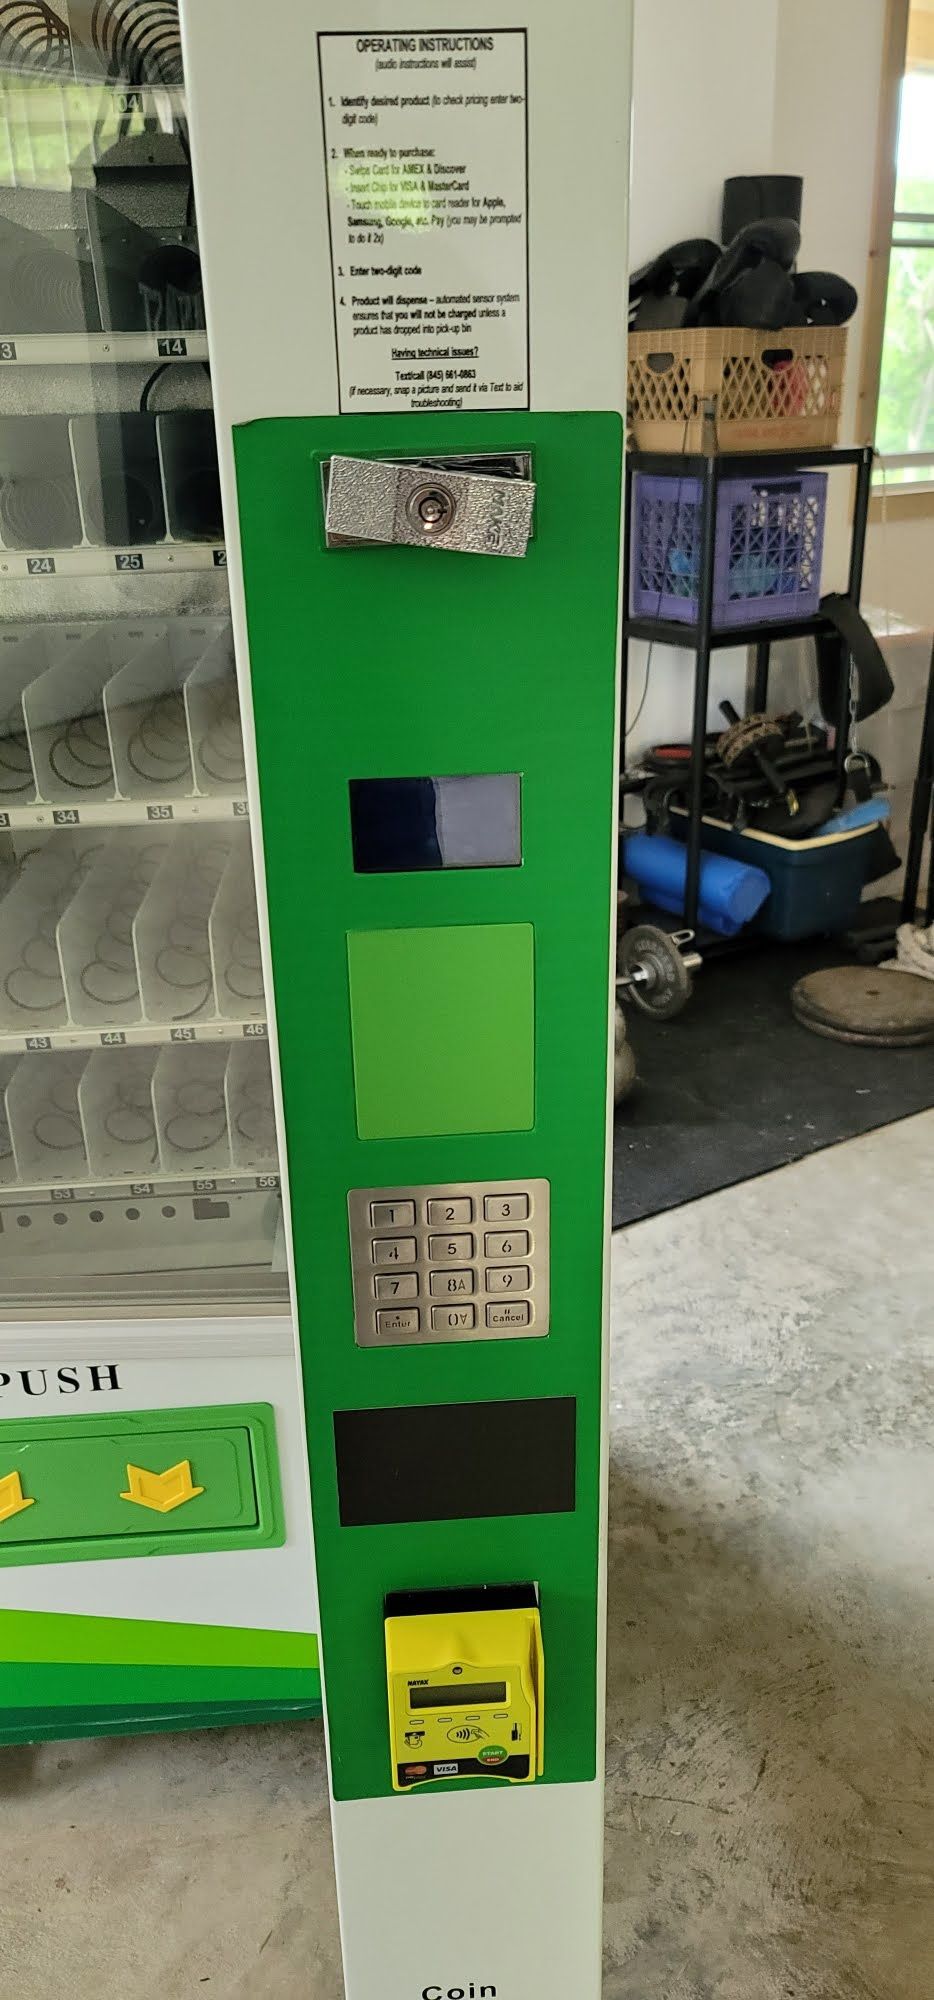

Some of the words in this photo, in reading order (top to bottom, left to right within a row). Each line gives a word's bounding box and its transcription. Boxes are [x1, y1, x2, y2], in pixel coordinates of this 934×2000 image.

[356, 39, 416, 52] OPERATING
[419, 37, 494, 51] INSTRUCTIONS
[375, 59, 397, 71] (audio
[399, 58, 439, 69] instructions
[442, 58, 452, 68] will
[454, 57, 476, 70] assist)
[329, 97, 335, 107] 1.
[341, 96, 369, 108] Identify
[371, 96, 398, 106] desired
[401, 95, 429, 107] product
[432, 95, 441, 107] (to
[443, 95, 463, 105] check
[465, 95, 488, 107] pricing
[490, 95, 507, 104] enter
[342, 114, 356, 126] digit
[359, 113, 378, 125] code)
[332, 149, 338, 159] 2.
[344, 148, 364, 158] When
[367, 149, 387, 159] ready
[389, 149, 397, 157] to
[399, 148, 435, 159] purchase:
[349, 164, 370, 177] Swipe
[373, 165, 389, 175] Card
[392, 165, 400, 175] for
[402, 164, 424, 174] AMEX
[434, 164, 466, 174] Discover
[351, 182, 370, 192] Insert
[401, 181, 418, 191] VISA
[428, 181, 469, 190] MasterCard
[351, 199, 372, 209] Touch
[431, 199, 446, 208] card
[448, 199, 470, 208] reader
[472, 198, 481, 207] for
[483, 198, 505, 209] Apple,
[347, 217, 383, 228] Samsung,
[386, 217, 414, 228] Google,
[431, 216, 444, 227] Pay
[447, 216, 460, 228] (you
[463, 217, 477, 226] may
[480, 215, 488, 224] be
[490, 214, 522, 225] prompted
[349, 235, 355, 243] to
[357, 235, 365, 243] do
[374, 233, 384, 244] 2x)
[338, 267, 344, 276] 3.
[350, 266, 369, 276] Enter
[371, 265, 403, 278] two-digit
[405, 265, 422, 275] code
[340, 297, 346, 306] 4.
[351, 296, 380, 306] Product
[382, 295, 394, 305] will
[396, 295, 428, 306] dispense
[436, 294, 470, 304] automated
[473, 295, 495, 303] sensor
[497, 293, 520, 305] system
[352, 311, 379, 321] ensures
[381, 311, 393, 320] that
[395, 312, 408, 322] you
[411, 310, 422, 319] will
[424, 310, 435, 319] not
[438, 310, 446, 318] be
[448, 309, 476, 320] charged
[479, 309, 500, 318] unless
[353, 326, 378, 337] product
[380, 325, 392, 334] has
[394, 324, 420, 336] dropped
[422, 324, 434, 333] into
[436, 323, 460, 335] pick-up
[462, 323, 472, 332] bin
[161, 340, 183, 354] 14
[392, 348, 416, 359] Having
[418, 347, 449, 357] technical
[452, 347, 479, 356] issues?
[395, 371, 425, 380] Text/call
[427, 370, 443, 382] (845)
[357, 387, 392, 397] necessary,
[394, 386, 410, 396] snap
[417, 385, 440, 395] picture
[442, 384, 454, 393] and
[456, 384, 471, 393] send
[479, 384, 488, 392] via
[490, 383, 504, 392] Text
[506, 383, 512, 391] to
[513, 382, 523, 391] aid
[411, 397, 462, 408] troubleshooting)
[30, 559, 50, 573] 24
[119, 555, 140, 569] 25
[56, 811, 76, 823] 34
[150, 807, 170, 818] 35
[173, 1029, 192, 1039] 45
[246, 1024, 264, 1035] 46
[29, 1038, 48, 1048] 43
[103, 1033, 122, 1043] 44
[196, 1180, 214, 1190] 55
[259, 1177, 276, 1187] 56
[53, 1189, 71, 1198] 53
[132, 1184, 150, 1194] 54
[389, 1209, 394, 1223] 1
[445, 1208, 454, 1220] 2
[502, 1204, 511, 1216] 3
[448, 1243, 457, 1254] 5
[502, 1240, 512, 1253] 6
[389, 1247, 399, 1260] 4
[502, 1275, 512, 1287] 9
[390, 1282, 400, 1294] 7
[493, 1314, 524, 1322] Cancel
[422, 1982, 496, 2000] Coin
